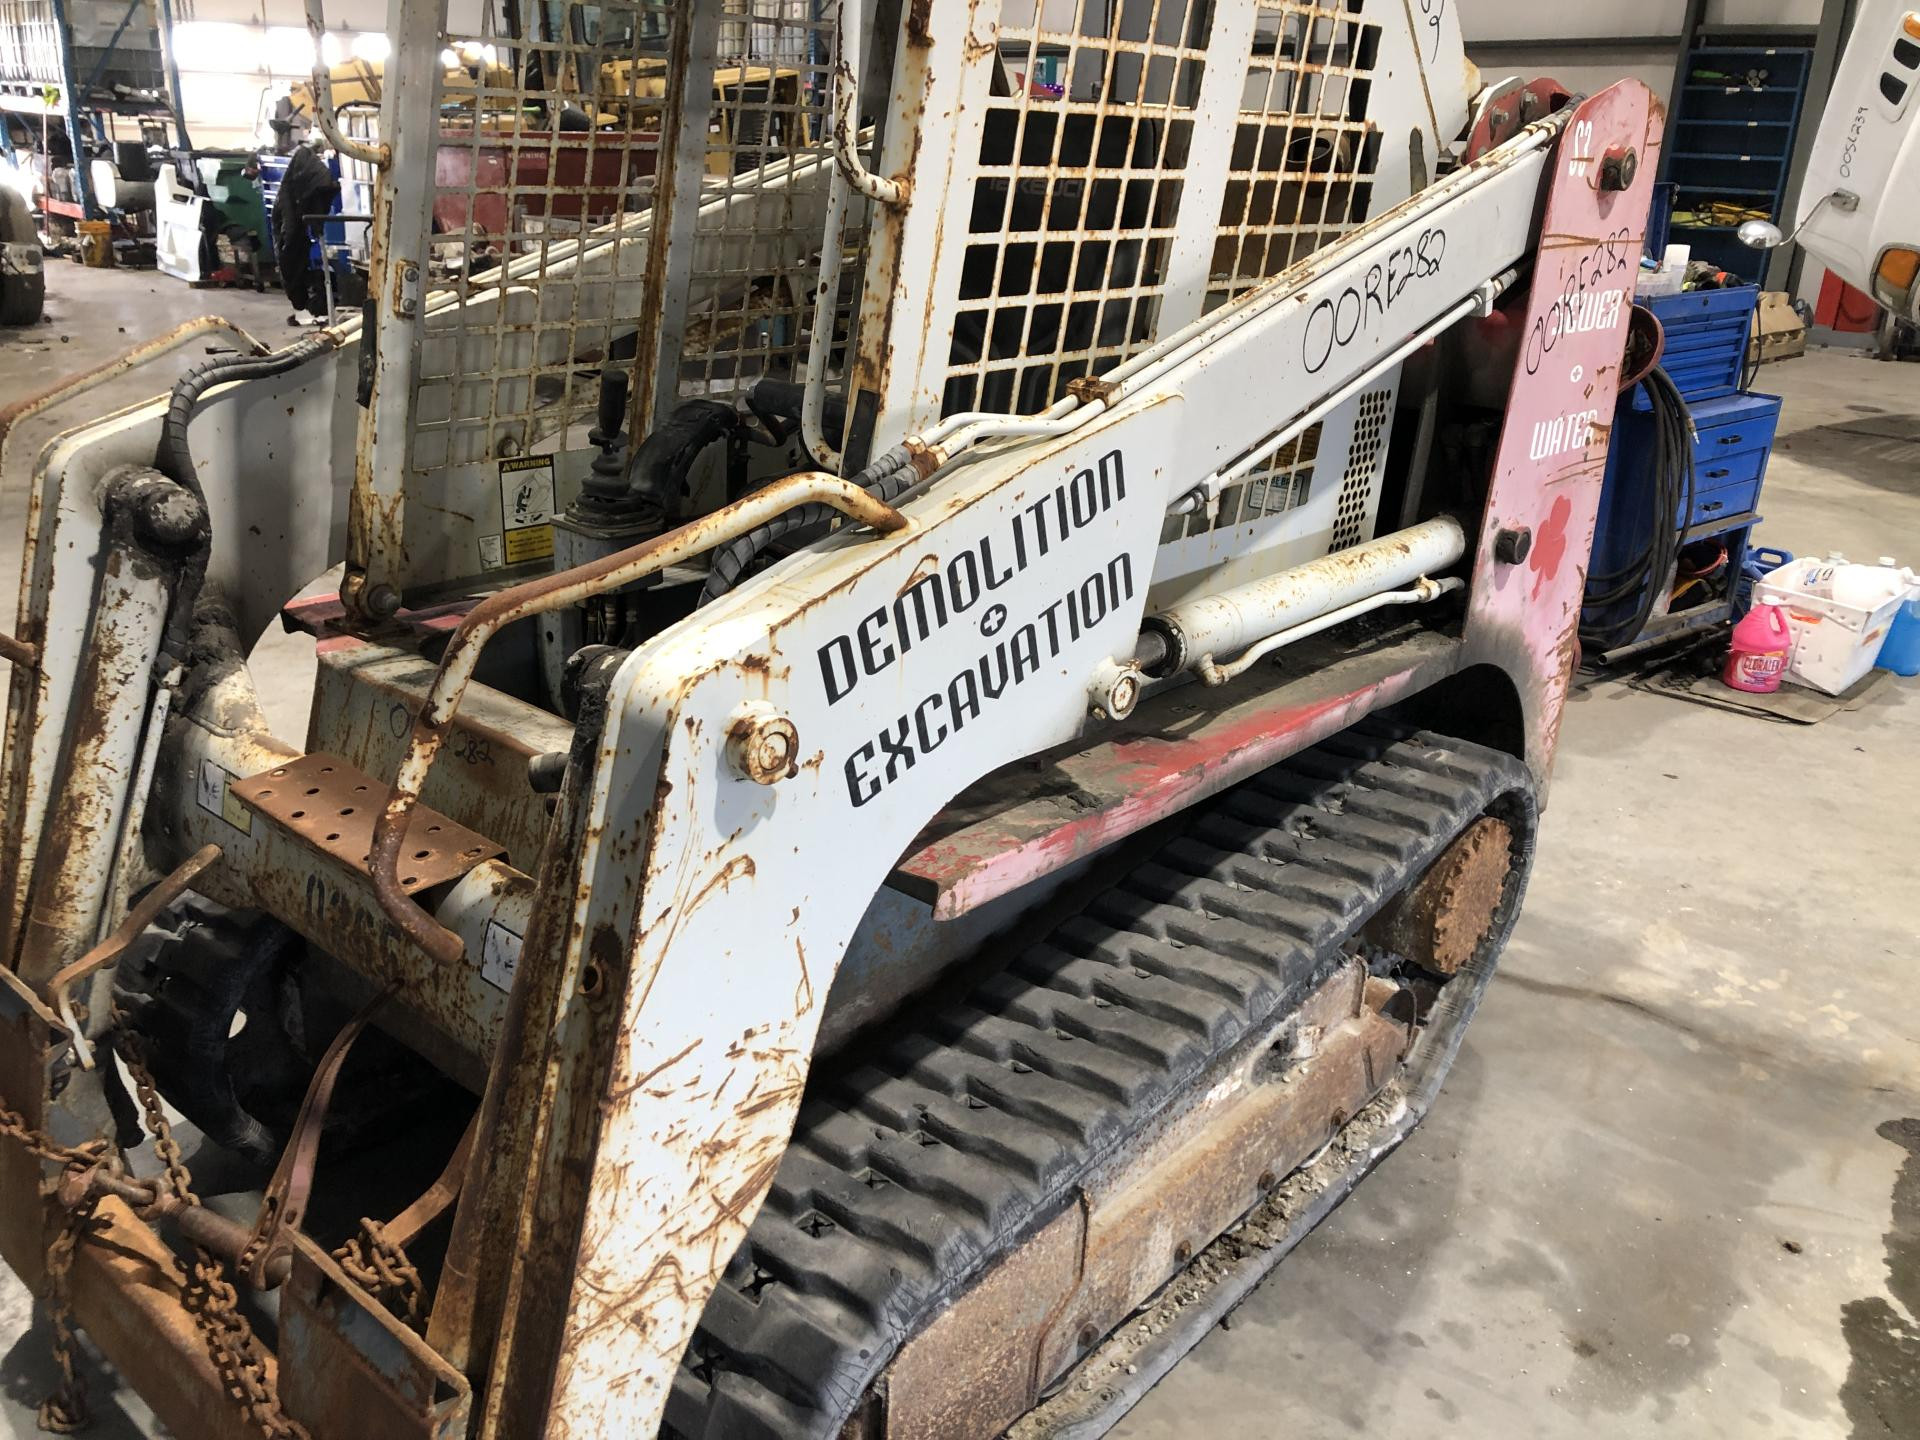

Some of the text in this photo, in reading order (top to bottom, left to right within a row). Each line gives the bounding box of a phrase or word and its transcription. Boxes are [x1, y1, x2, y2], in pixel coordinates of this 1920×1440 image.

[1551, 289, 1623, 336] SEWER
[1530, 409, 1598, 460] WATER
[511, 458, 550, 469] WARNING
[817, 449, 1126, 706] DEMOLITION
[844, 552, 1134, 807] EXCAVATION
